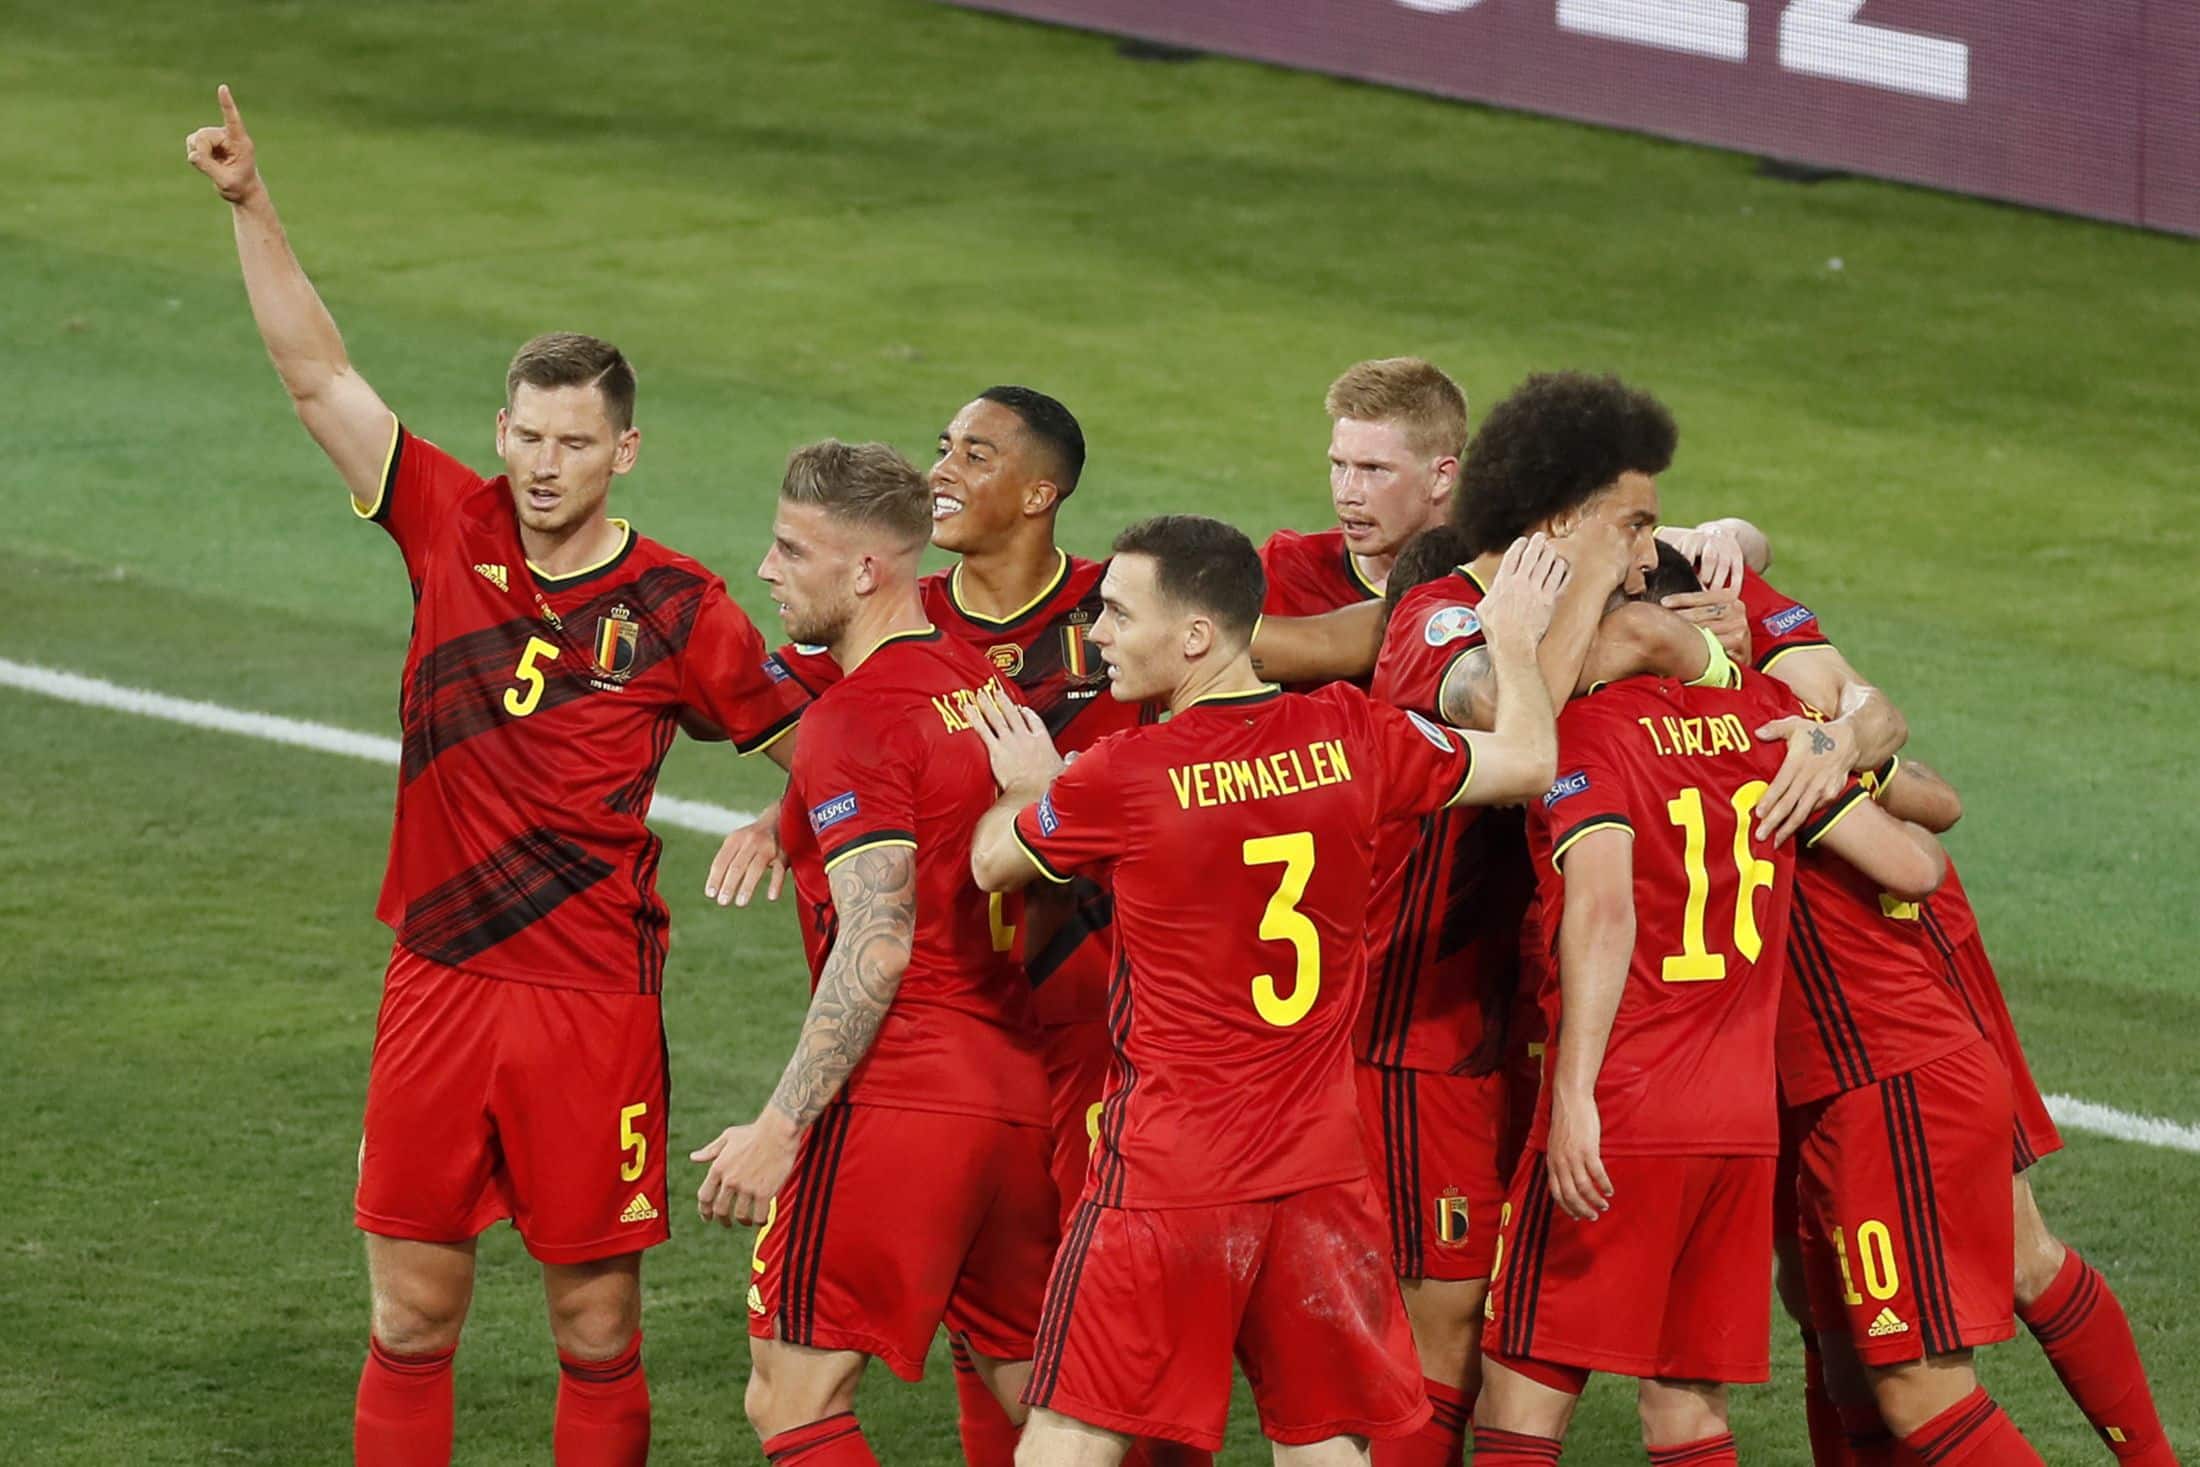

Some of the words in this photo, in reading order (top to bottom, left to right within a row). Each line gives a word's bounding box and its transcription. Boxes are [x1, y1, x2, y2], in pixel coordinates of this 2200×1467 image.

[503, 636, 560, 717] 5
[817, 796, 856, 823] RESPECT
[1168, 739, 1352, 809] VERMAELEN
[1243, 831, 1321, 1027] 3
[621, 1102, 647, 1181] 5
[620, 1208, 659, 1224] adidas
[1833, 1220, 1899, 1305] 10
[1868, 1321, 1909, 1337] adidas
